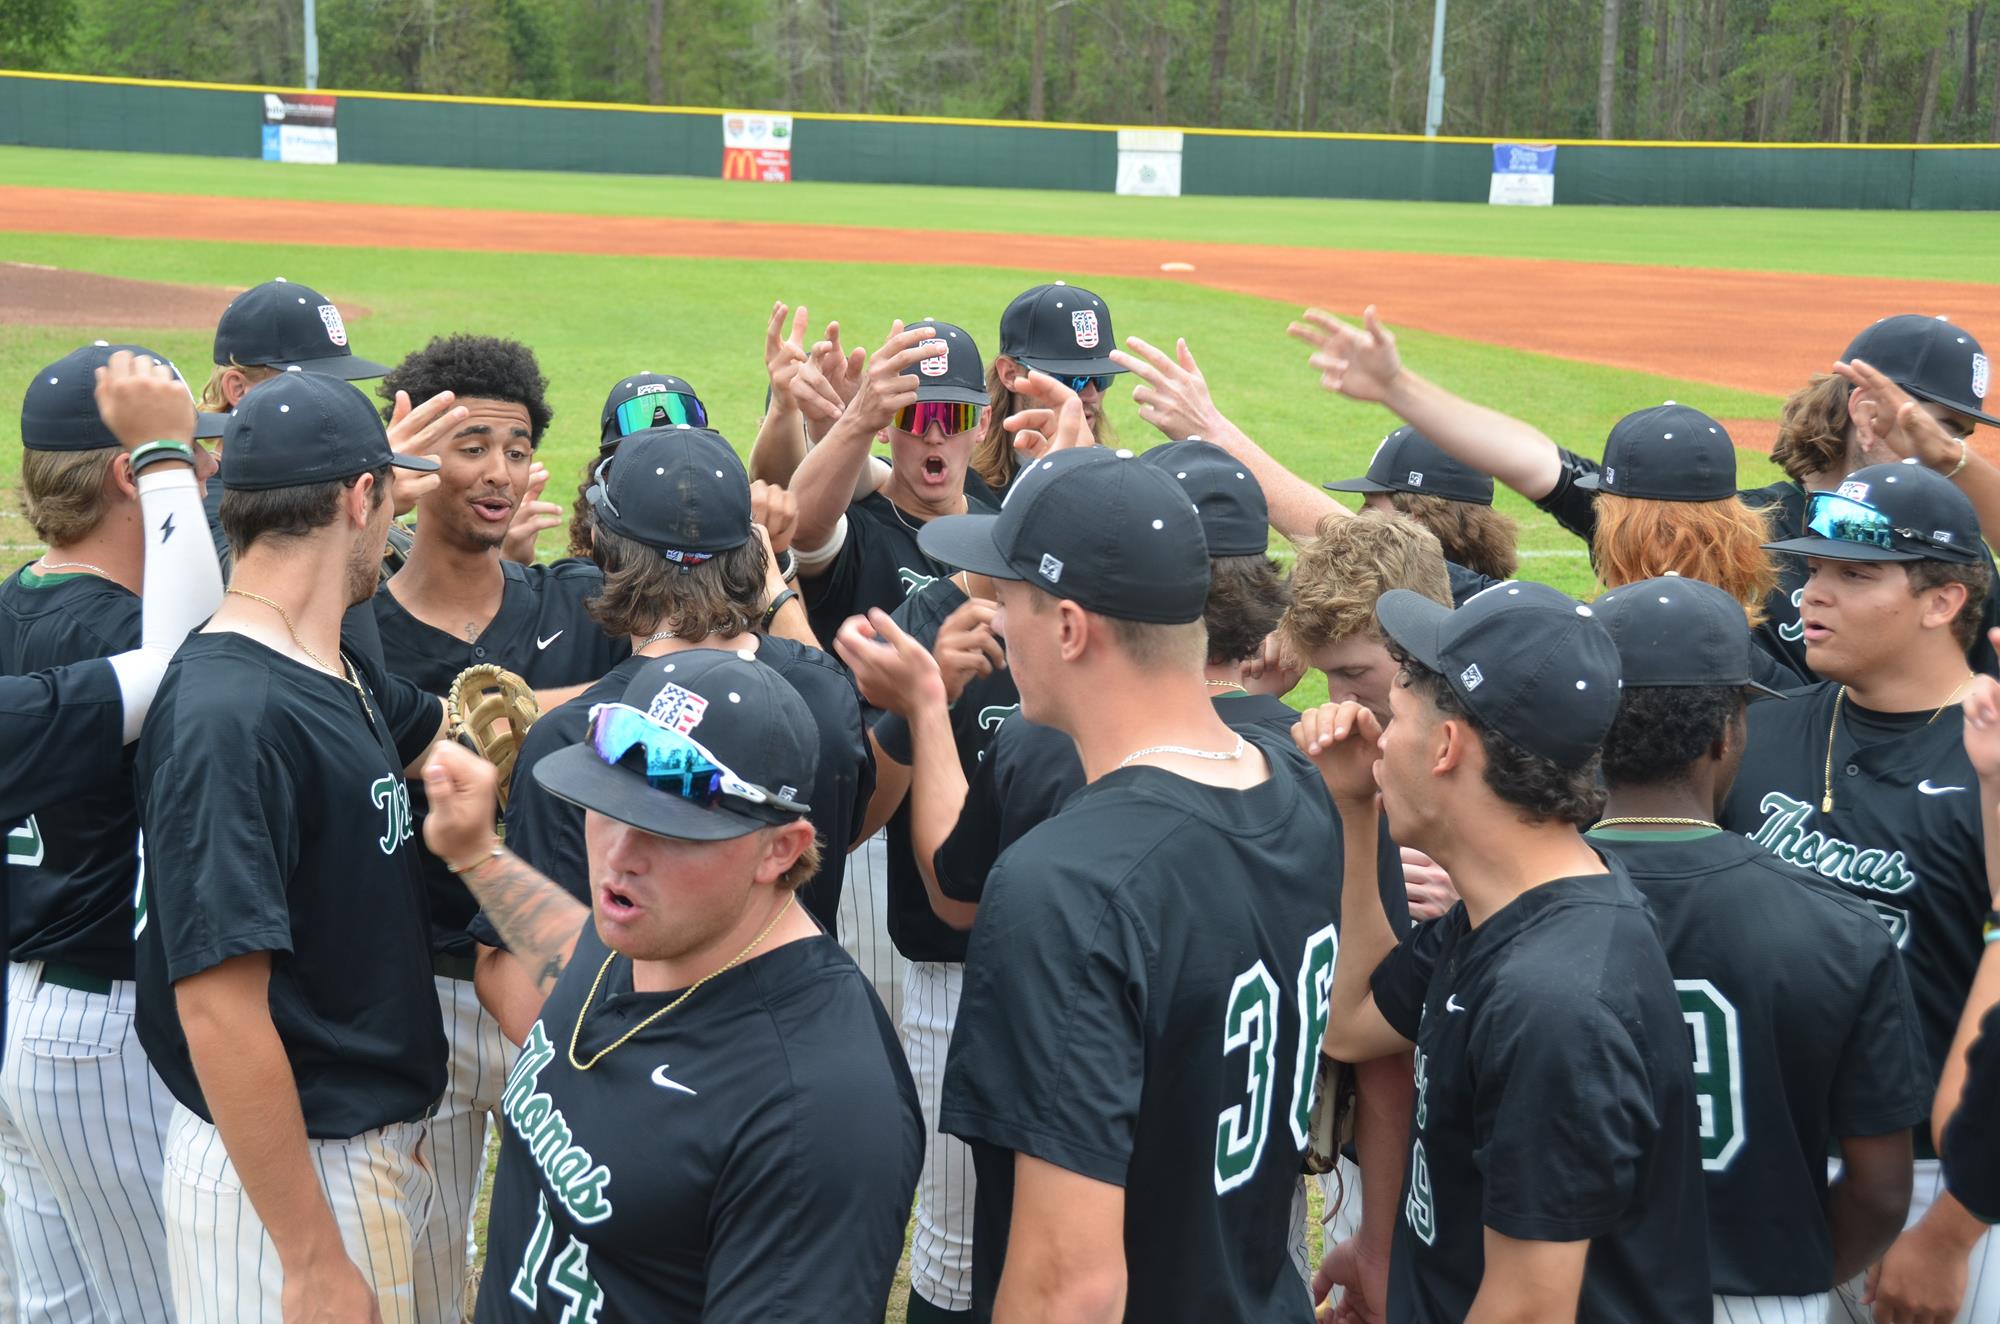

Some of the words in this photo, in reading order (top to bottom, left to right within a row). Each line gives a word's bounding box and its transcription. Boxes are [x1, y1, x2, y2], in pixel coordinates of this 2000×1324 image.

[1745, 791, 1916, 895] Thomas
[500, 1018, 613, 1225] Thomas
[1214, 922, 1340, 1197] 36
[510, 1188, 605, 1324] 14
